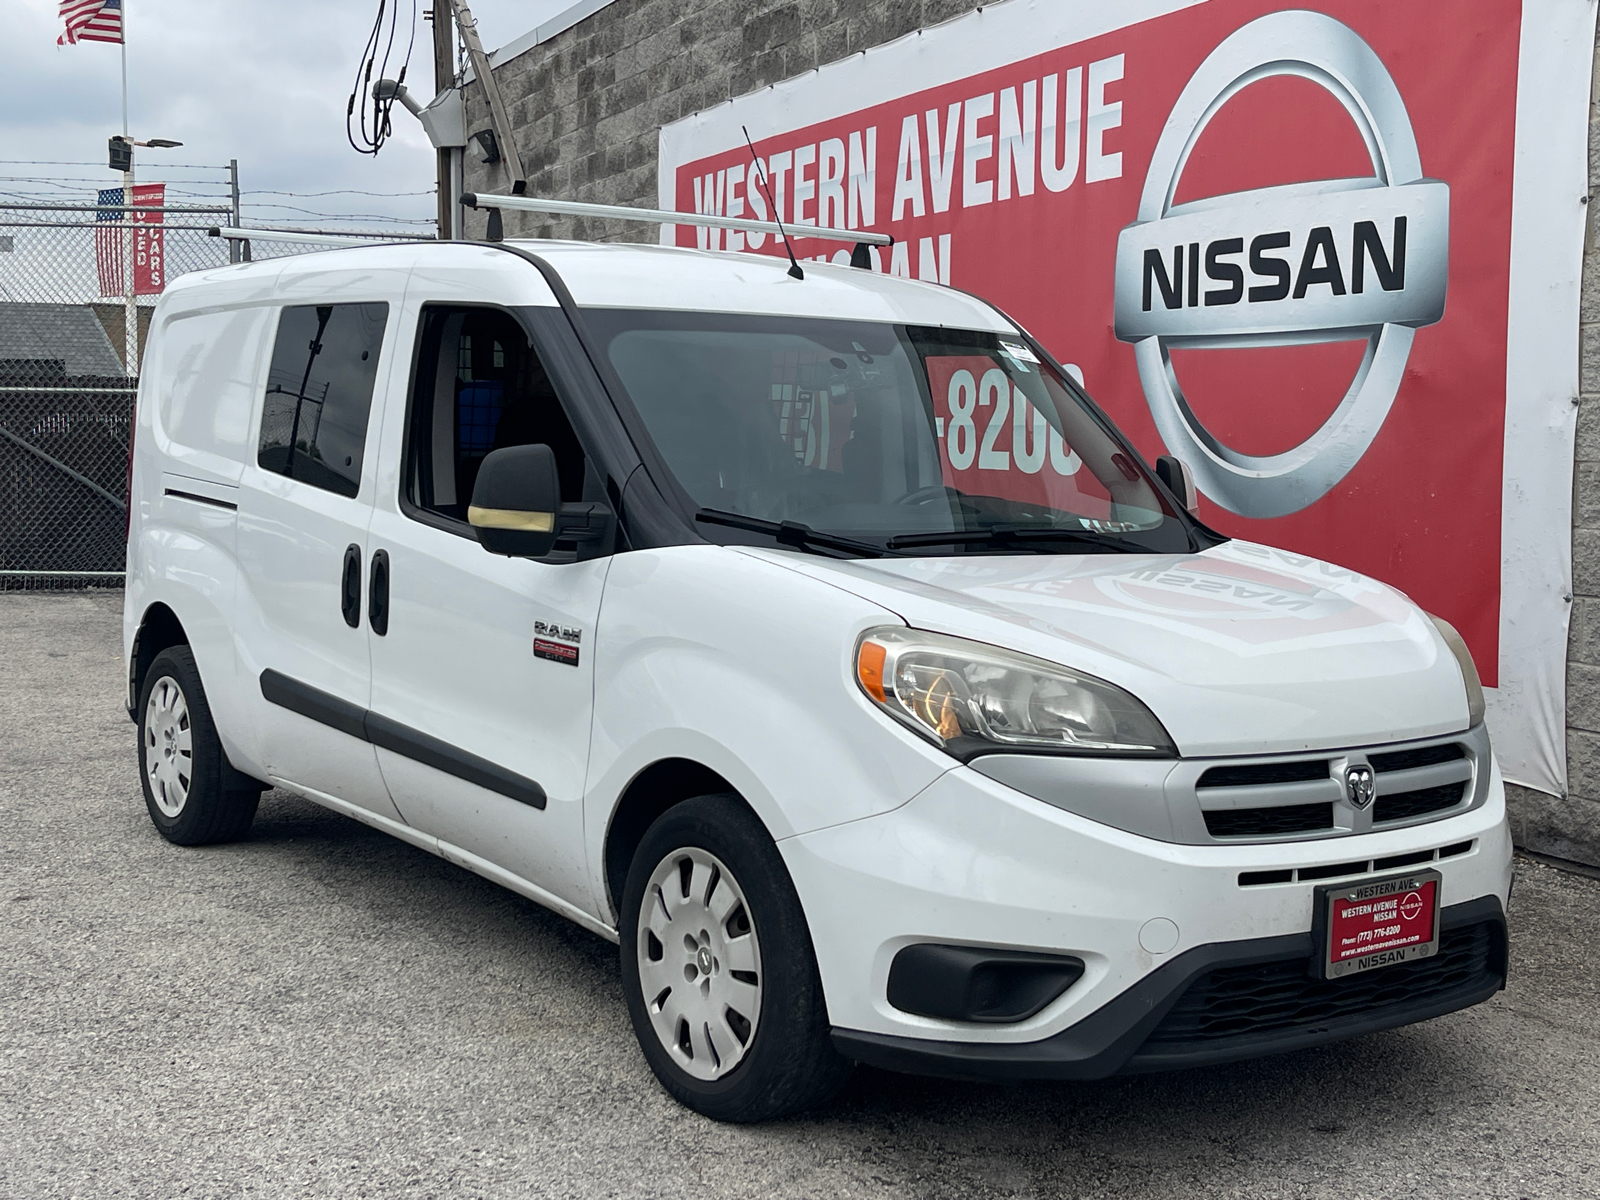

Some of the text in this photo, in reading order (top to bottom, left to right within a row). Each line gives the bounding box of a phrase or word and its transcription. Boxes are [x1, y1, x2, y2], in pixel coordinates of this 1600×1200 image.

[693, 53, 1125, 251] WESTERN AVENUE
[149, 226, 161, 286] CARS
[1142, 215, 1407, 312] NISSAN
[534, 620, 582, 644] RAM
[1356, 881, 1396, 899] WESTERN
[1341, 899, 1398, 919] WESTERN AVENUE
[1373, 909, 1397, 922] NISSAN
[1400, 901, 1423, 910] NISSAN
[1341, 924, 1401, 946] Phone: (773) 776-8200
[1358, 949, 1405, 970] NISSAN
